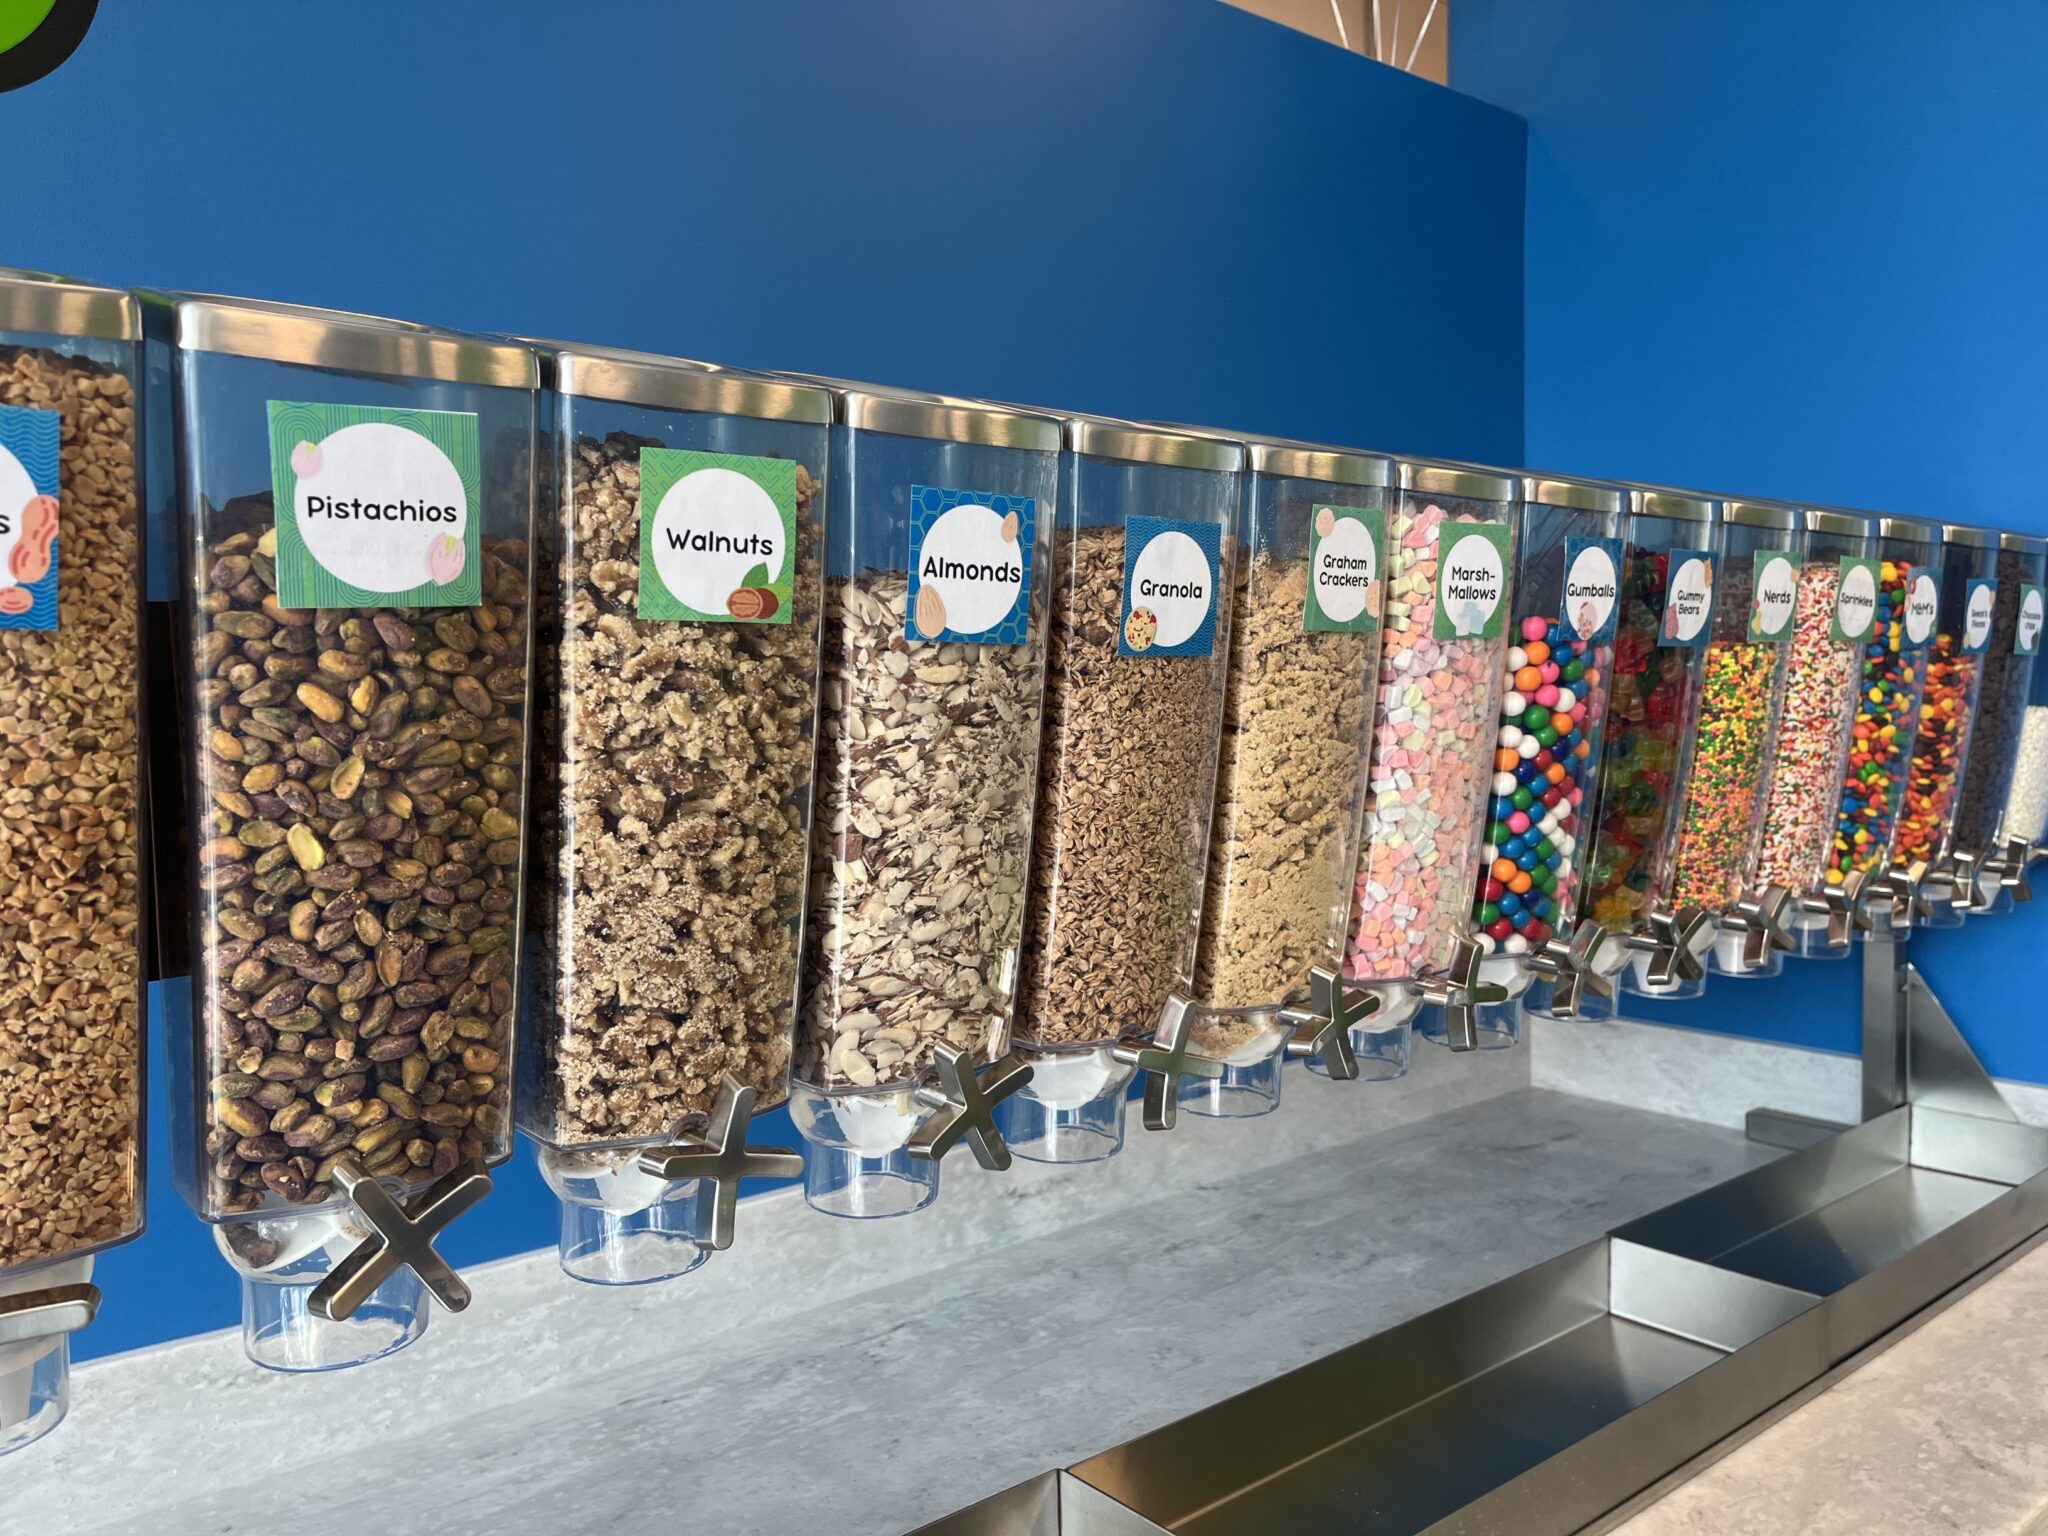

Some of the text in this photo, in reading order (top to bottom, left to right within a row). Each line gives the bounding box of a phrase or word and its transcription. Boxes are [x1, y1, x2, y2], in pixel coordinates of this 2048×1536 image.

[307, 496, 457, 523] Pistachios
[666, 528, 773, 555] Walnuts
[923, 556, 1021, 583] Almonds
[1323, 554, 1367, 570] Graham
[1320, 571, 1369, 588] Crackers
[1451, 566, 1496, 582] Marsh-
[1140, 579, 1203, 599] Granola
[1448, 585, 1496, 600] Mallows
[1567, 583, 1615, 598] Gumballs
[1677, 589, 1705, 604] Gummy
[1763, 589, 1791, 604] Nerds
[1678, 603, 1700, 615] Bears
